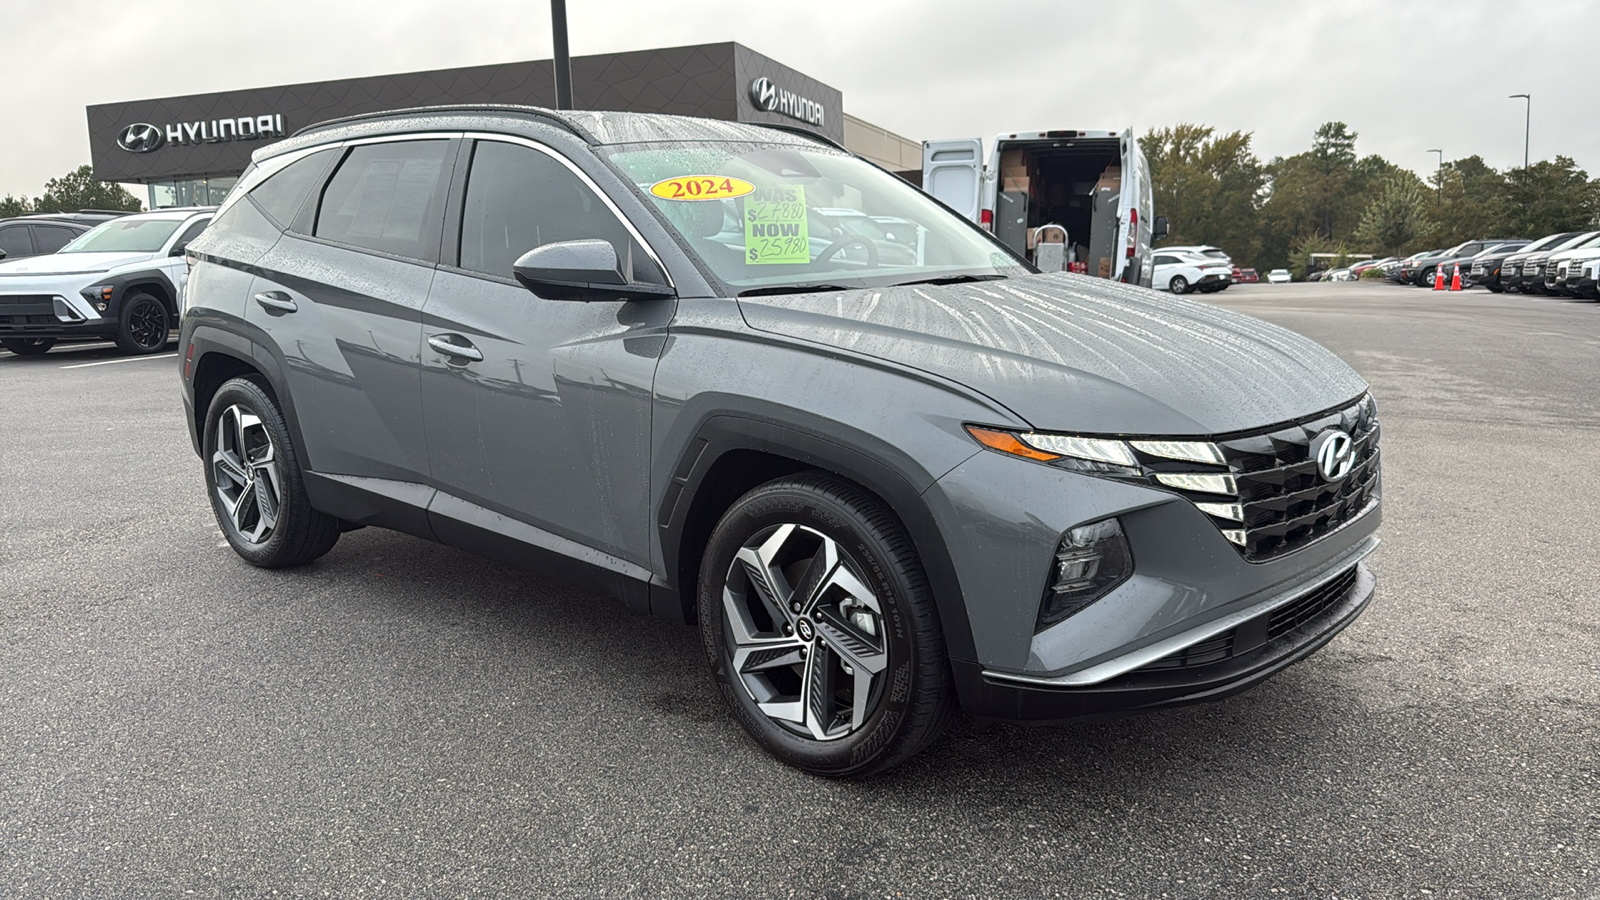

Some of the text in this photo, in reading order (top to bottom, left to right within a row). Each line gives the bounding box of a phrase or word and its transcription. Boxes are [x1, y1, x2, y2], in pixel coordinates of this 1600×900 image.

[779, 90, 824, 126] HYUNDAI
[166, 113, 284, 144] HYUNDAI
[668, 179, 734, 198] 2024
[753, 188, 798, 202] WAS
[752, 223, 800, 237] NOW
